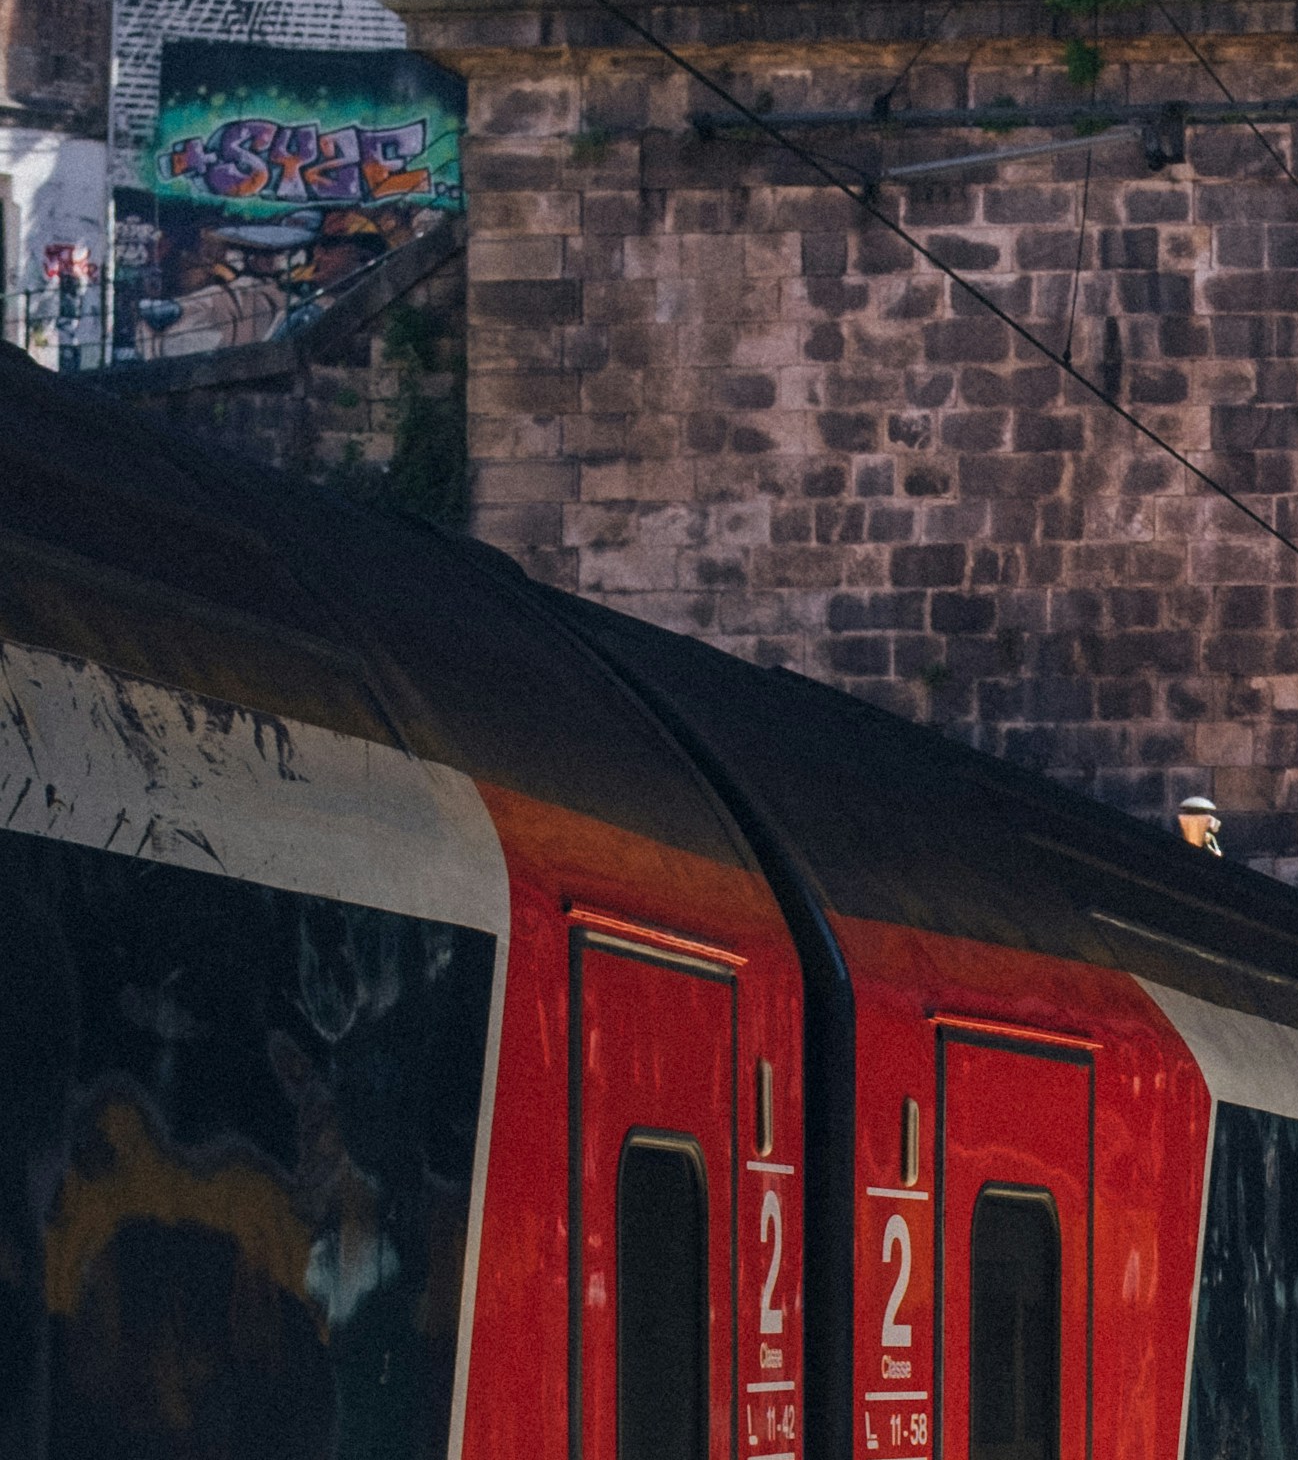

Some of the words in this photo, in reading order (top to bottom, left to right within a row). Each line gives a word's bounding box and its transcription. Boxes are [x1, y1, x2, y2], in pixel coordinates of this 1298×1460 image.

[760, 1190, 783, 1334] 2
[881, 1214, 913, 1347] 2
[881, 1355, 912, 1379] Classe
